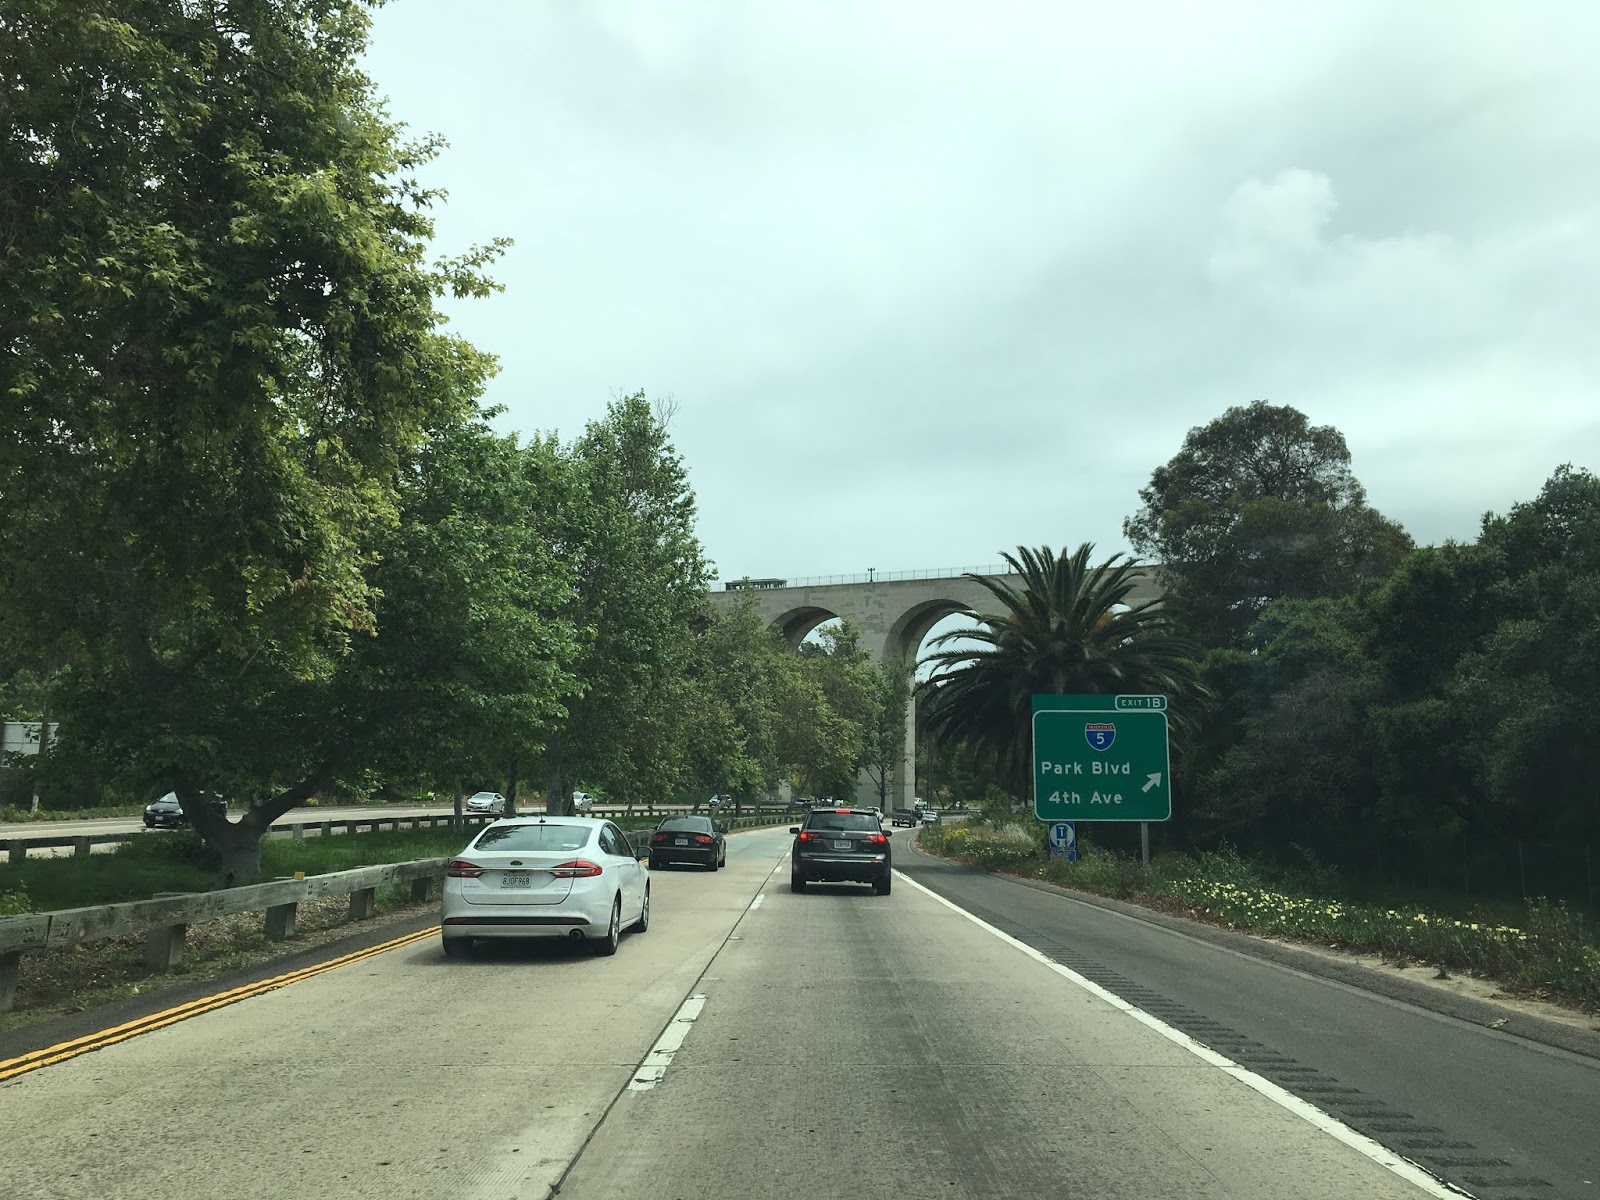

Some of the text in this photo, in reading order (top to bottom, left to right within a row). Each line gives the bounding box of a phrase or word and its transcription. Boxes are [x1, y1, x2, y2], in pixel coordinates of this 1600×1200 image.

[1146, 698, 1161, 708] 1B
[1097, 732, 1105, 744] 5
[1041, 761, 1130, 774] Park Blvd
[1048, 791, 1123, 804] 4th Ave
